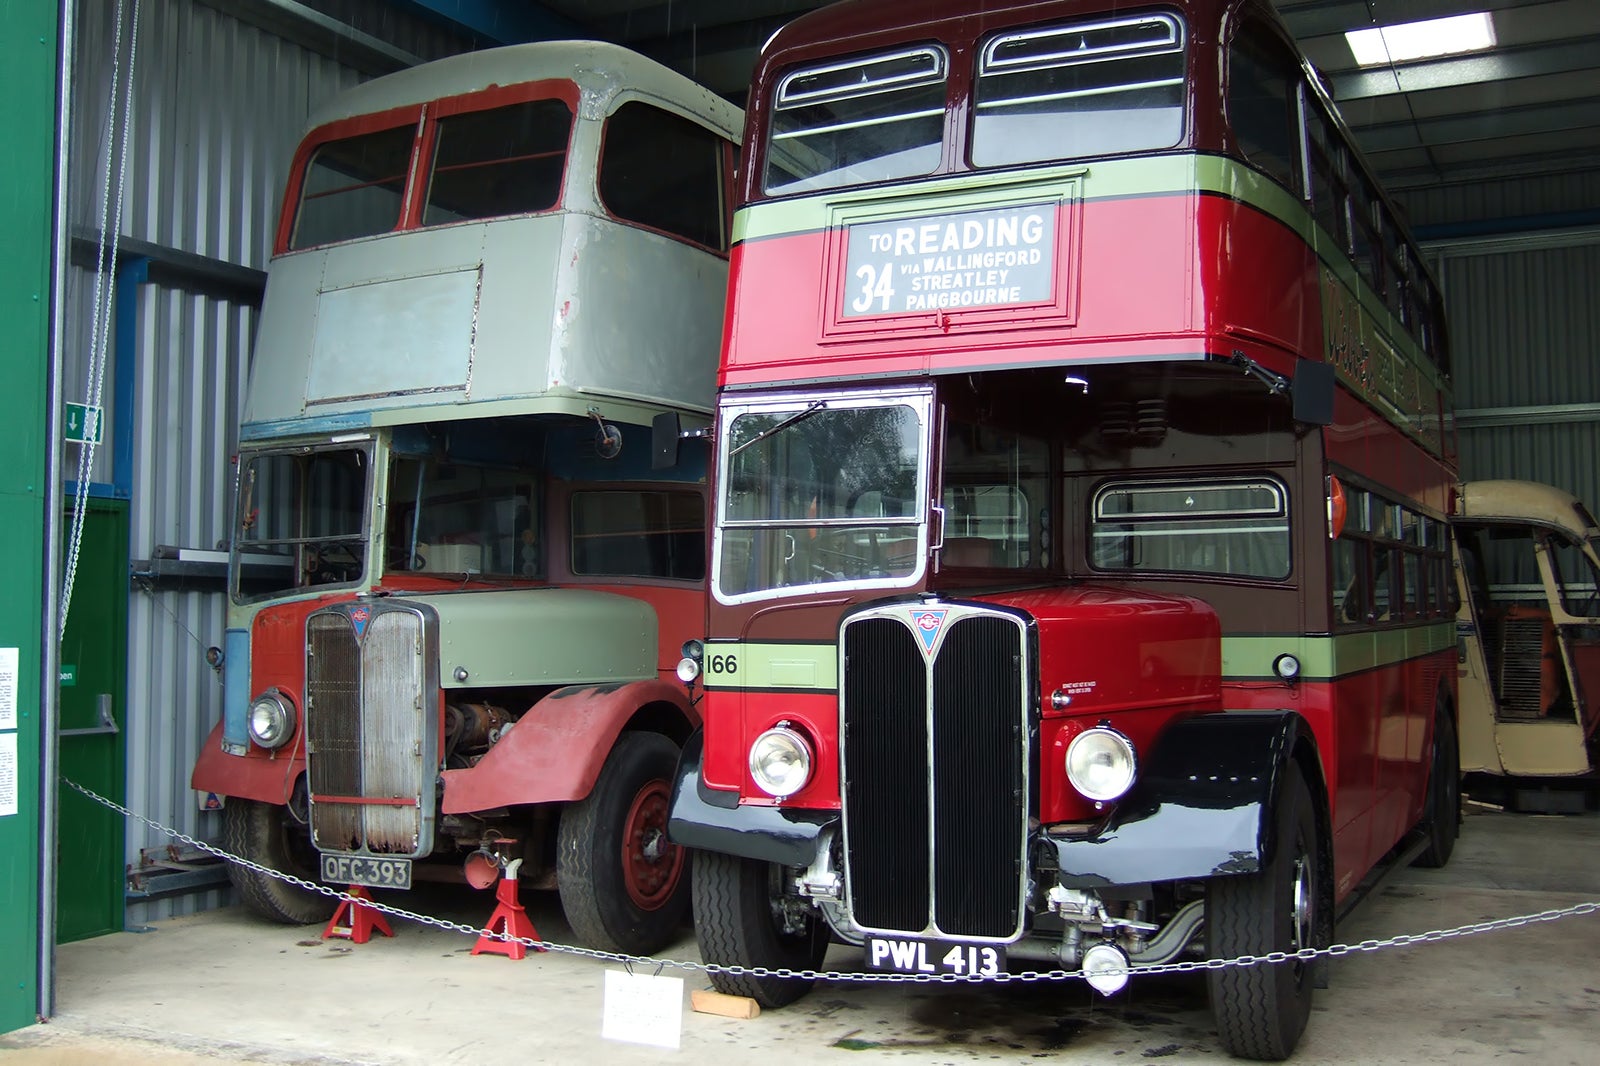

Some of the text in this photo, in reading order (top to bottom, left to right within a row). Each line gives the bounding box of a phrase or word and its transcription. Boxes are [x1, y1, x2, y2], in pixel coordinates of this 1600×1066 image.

[869, 214, 1044, 256] TO READING
[923, 248, 1041, 274] WALLINGFORD
[852, 262, 895, 313] 34
[911, 269, 1009, 292] STREATLEY
[905, 286, 1021, 310] PANGBOURNE
[707, 654, 738, 674] 166
[325, 857, 407, 885] OFC 393
[871, 939, 999, 976] PWL 413
